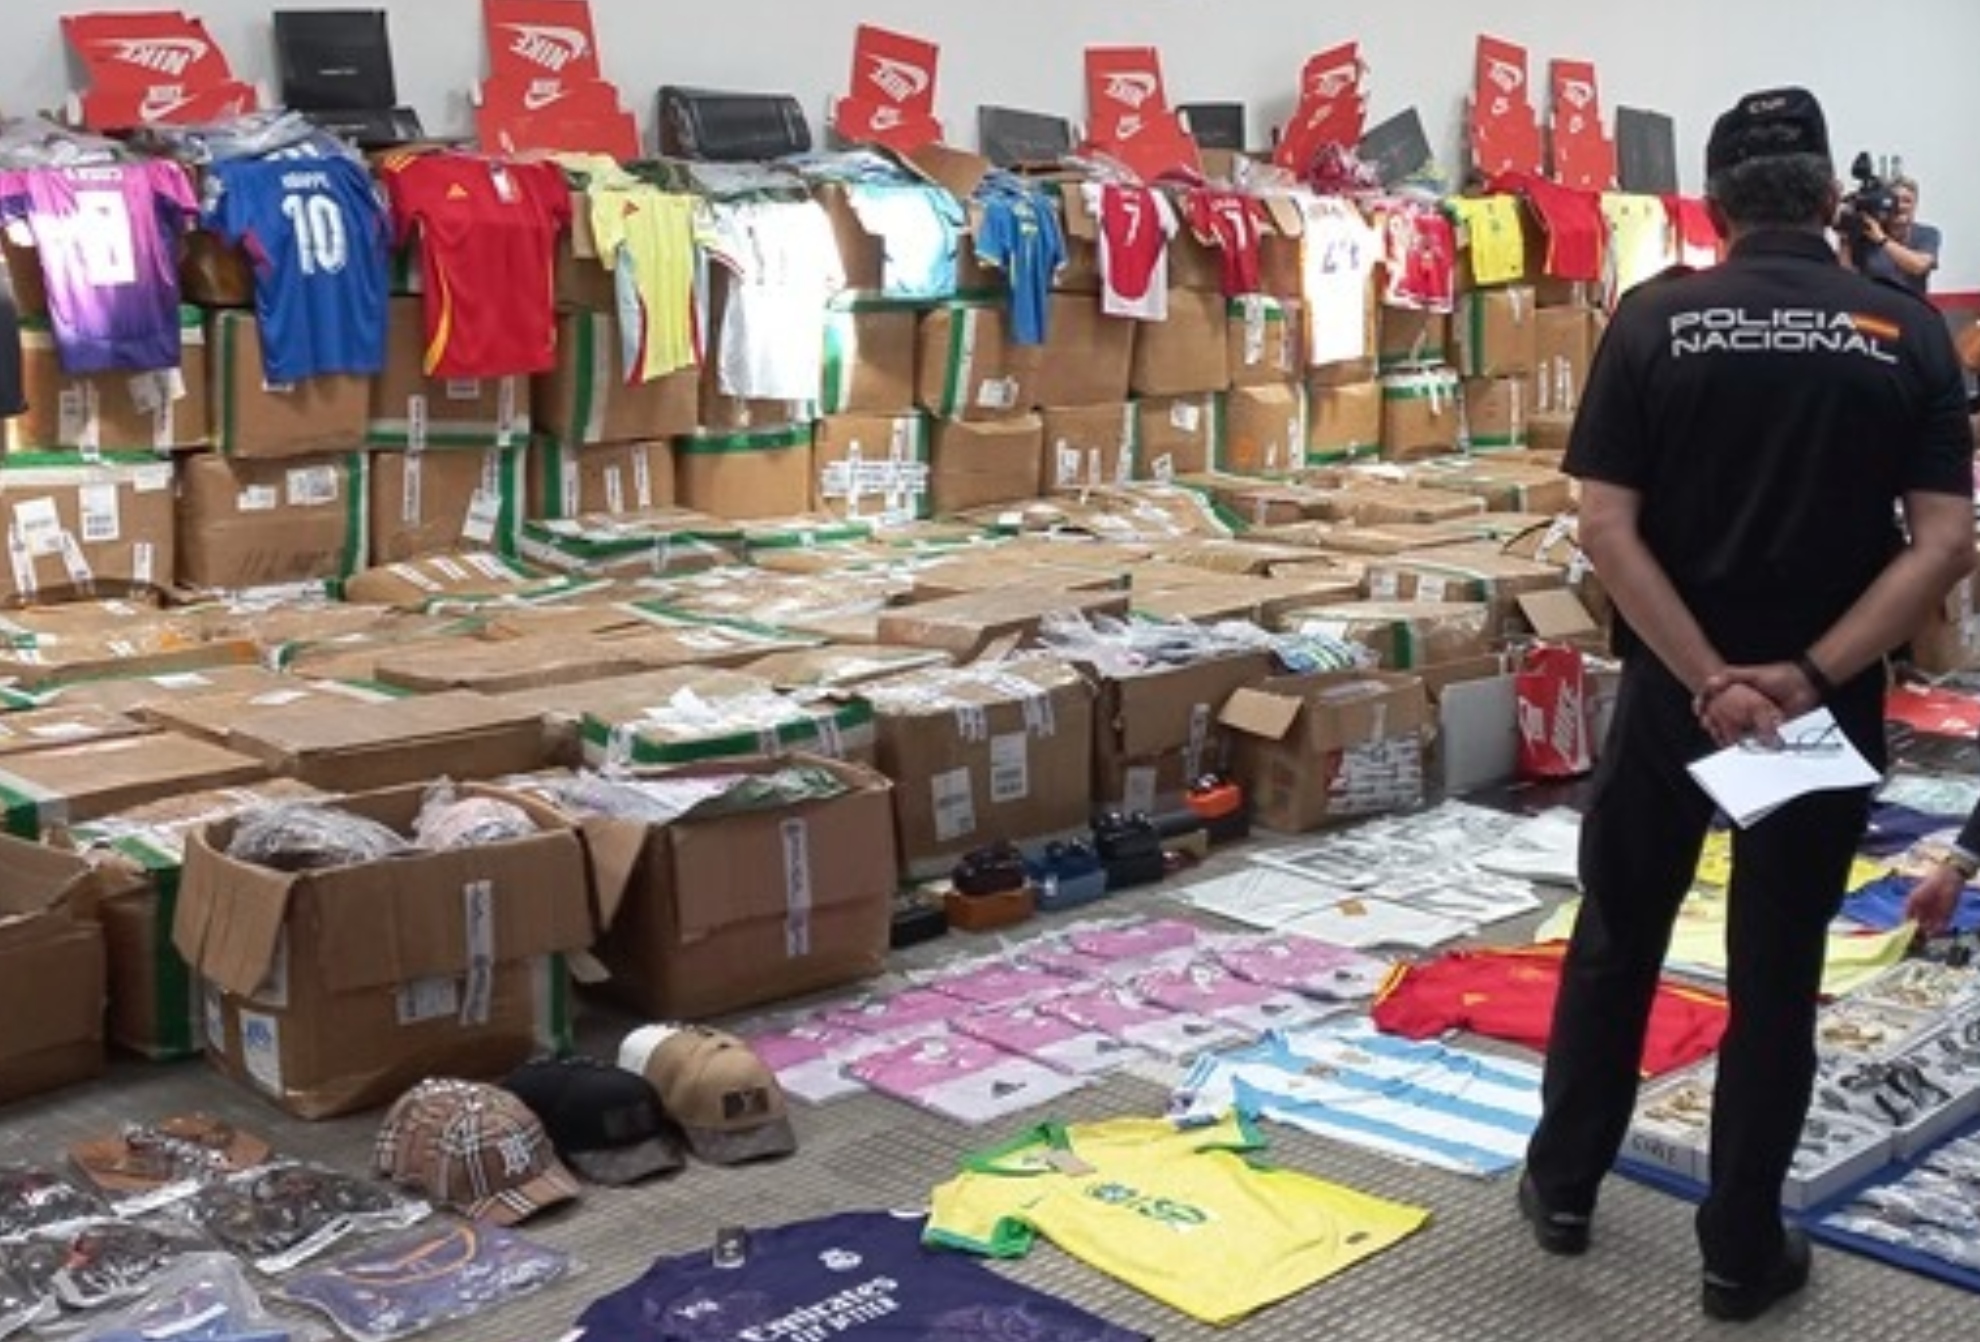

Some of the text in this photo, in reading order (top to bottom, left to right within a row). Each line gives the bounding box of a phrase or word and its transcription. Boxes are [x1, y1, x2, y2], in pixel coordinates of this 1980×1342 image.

[281, 194, 348, 274] 10
[1122, 202, 1141, 247] 7
[1670, 307, 1857, 336] POLICIA
[1671, 331, 1898, 365] NACIONAL
